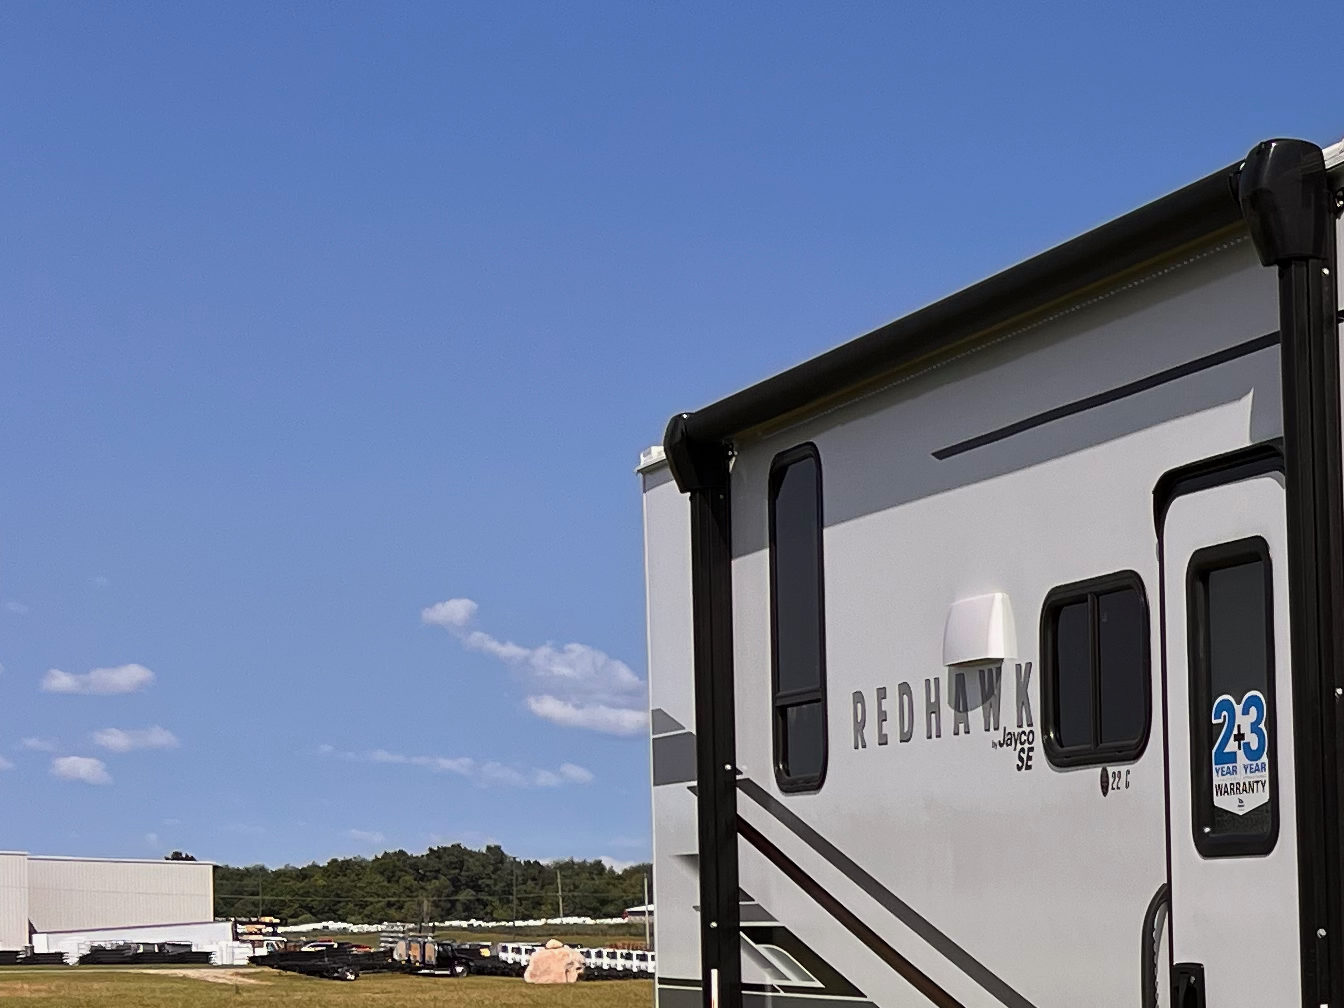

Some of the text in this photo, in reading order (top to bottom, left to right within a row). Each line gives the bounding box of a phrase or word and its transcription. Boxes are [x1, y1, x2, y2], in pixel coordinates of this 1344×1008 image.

[852, 662, 1034, 749] REDHAWK
[998, 726, 1035, 751] Jayco
[1016, 746, 1035, 772] SE
[1214, 761, 1267, 777] YEAR YEAR
[1214, 779, 1267, 797] WARRANTY
